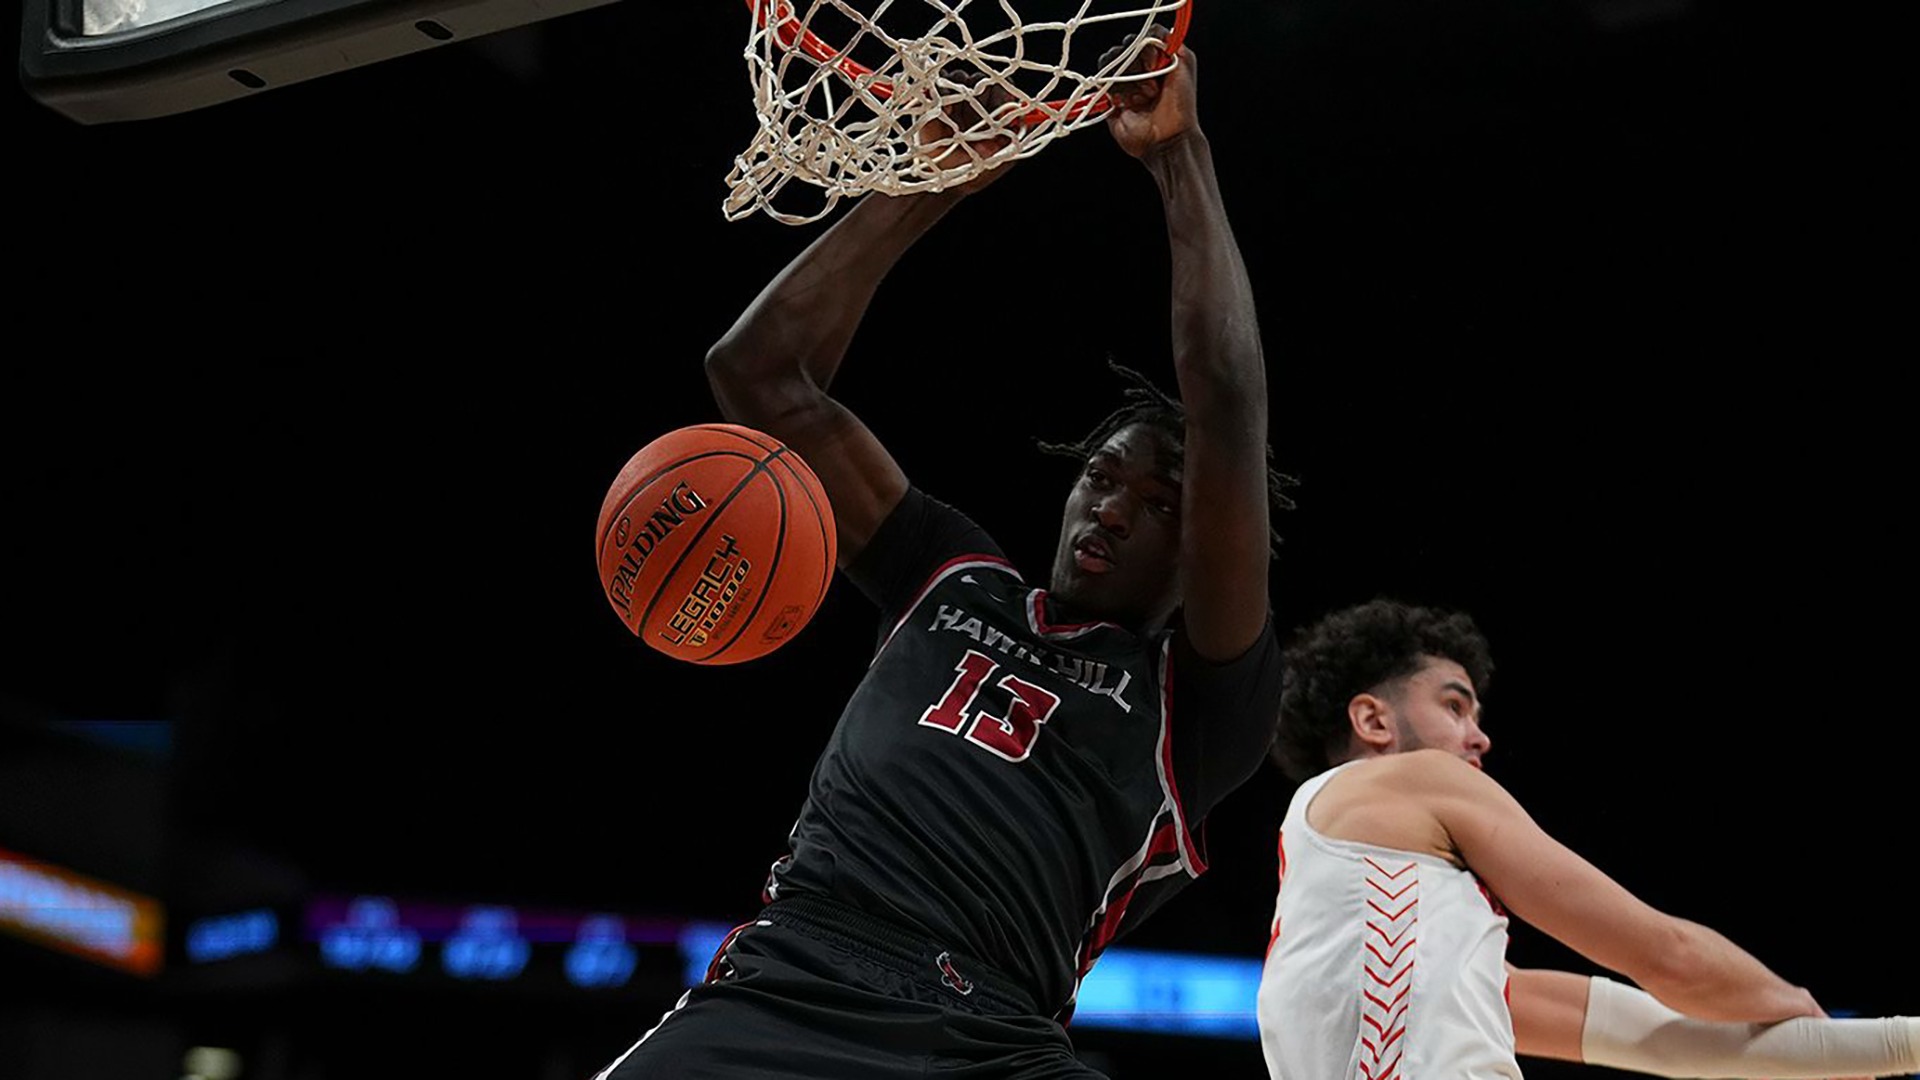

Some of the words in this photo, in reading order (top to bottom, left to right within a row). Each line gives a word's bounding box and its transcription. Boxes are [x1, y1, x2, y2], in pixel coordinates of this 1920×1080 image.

[609, 481, 707, 618] SPALDING
[659, 534, 741, 646] LEGACY
[918, 649, 1061, 762] 13
